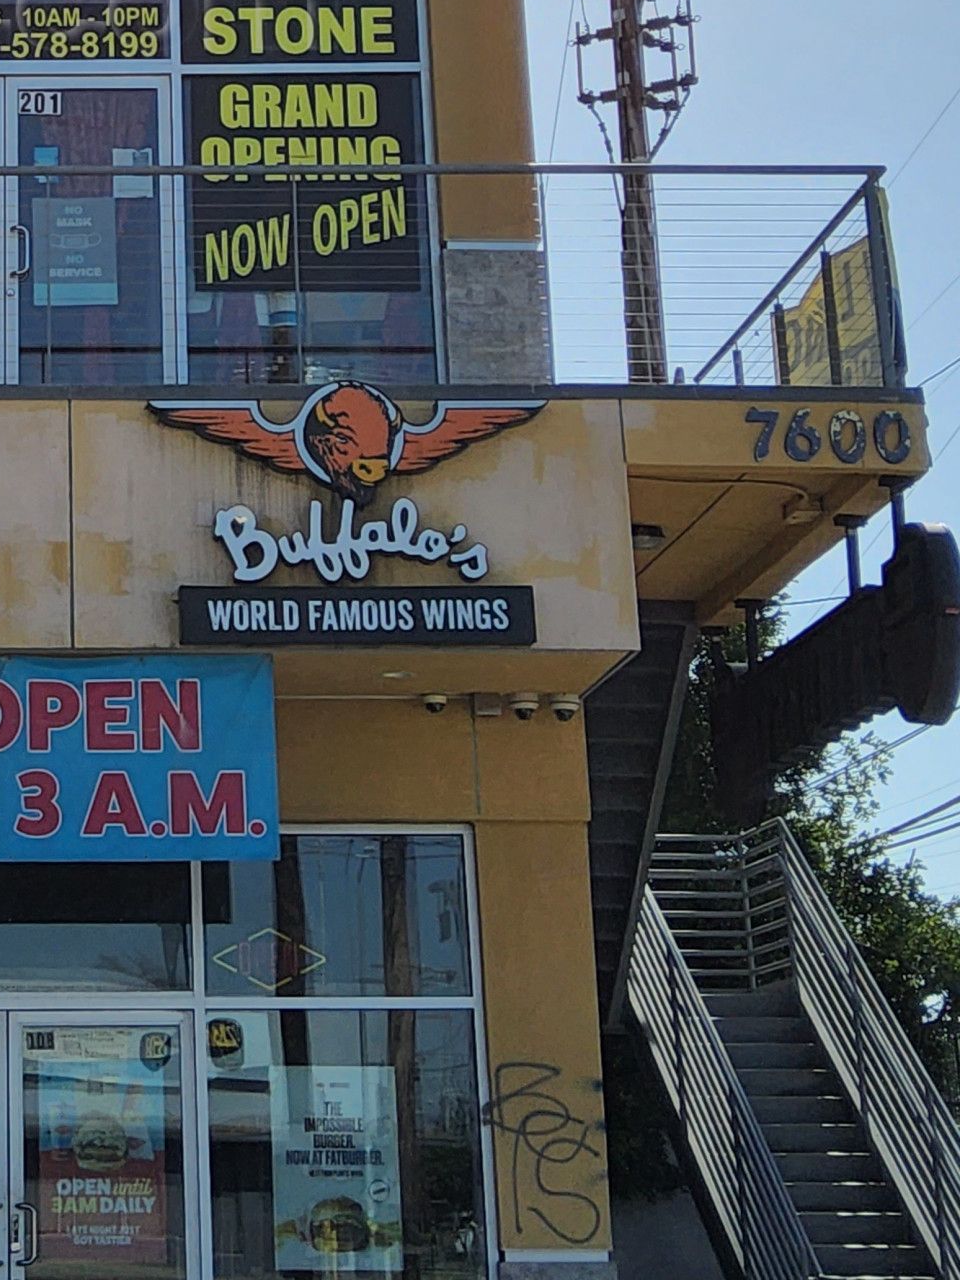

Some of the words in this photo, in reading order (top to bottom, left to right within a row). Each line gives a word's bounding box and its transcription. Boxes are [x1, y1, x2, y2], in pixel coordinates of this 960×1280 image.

[22, 7, 81, 27] 10AM
[101, 7, 159, 27] 10PM
[203, 6, 396, 55] STONE
[20, 93, 60, 114] 201
[219, 84, 378, 129] GRAND
[200, 136, 403, 182] OPENING
[56, 218, 93, 227] MASK
[64, 206, 83, 215] NO
[205, 213, 291, 285] NOW
[312, 185, 407, 257] OPEN
[49, 267, 102, 277] SERVICE
[65, 255, 84, 264] NO
[745, 406, 911, 465] 7600
[214, 496, 490, 582] Buffalo's
[206, 598, 300, 632] WORLD
[307, 599, 415, 632] FAMOUS
[421, 598, 510, 631] WINGS
[13, 768, 62, 839] 3
[79, 769, 269, 838] A.M.
[56, 1177, 112, 1196] OPEN
[112, 1178, 154, 1197] until
[51, 1196, 98, 1214] 3AM
[99, 1196, 157, 1214] DAILY
